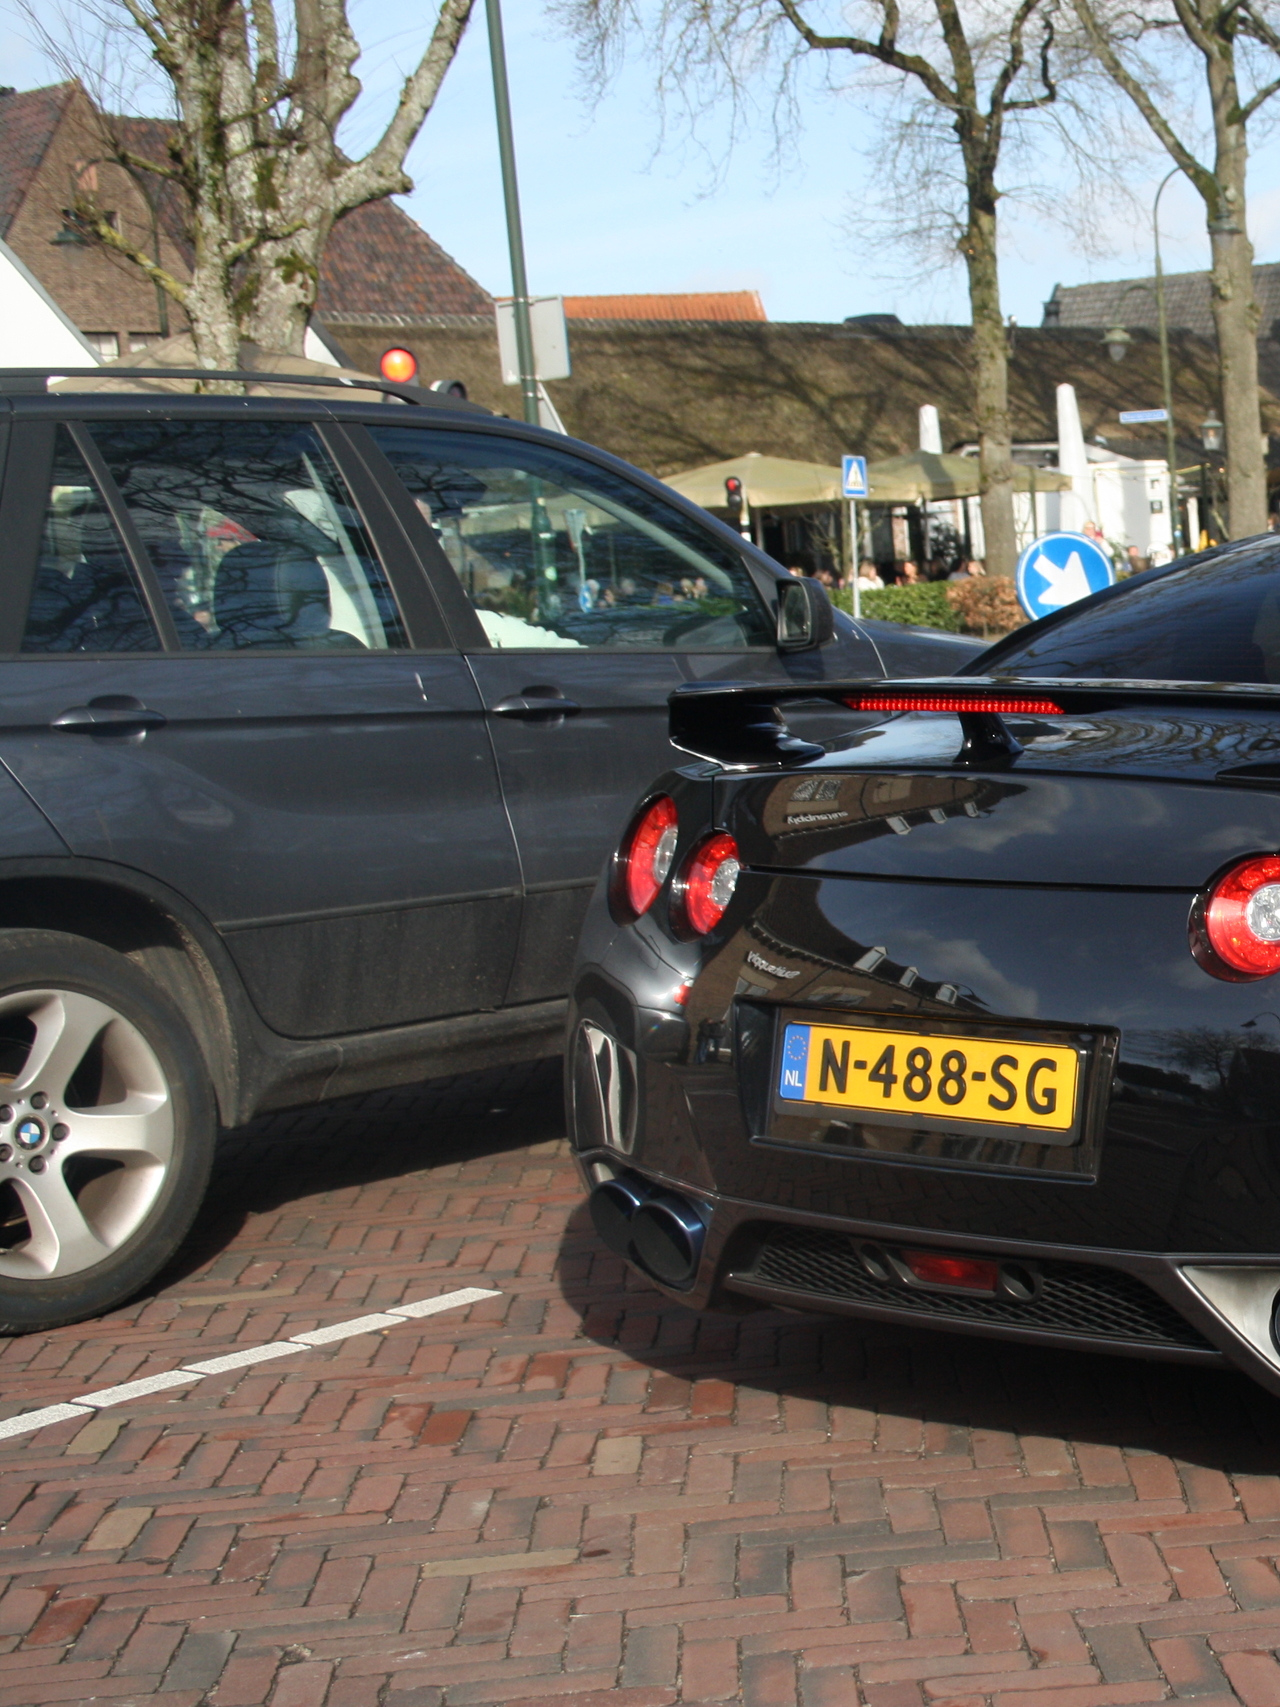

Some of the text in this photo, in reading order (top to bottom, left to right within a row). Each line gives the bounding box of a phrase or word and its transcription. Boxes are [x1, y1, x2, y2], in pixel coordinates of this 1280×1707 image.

[787, 811, 849, 825] suitsupply
[784, 1069, 803, 1088] NL
[818, 1037, 1058, 1116] N-488-SG
